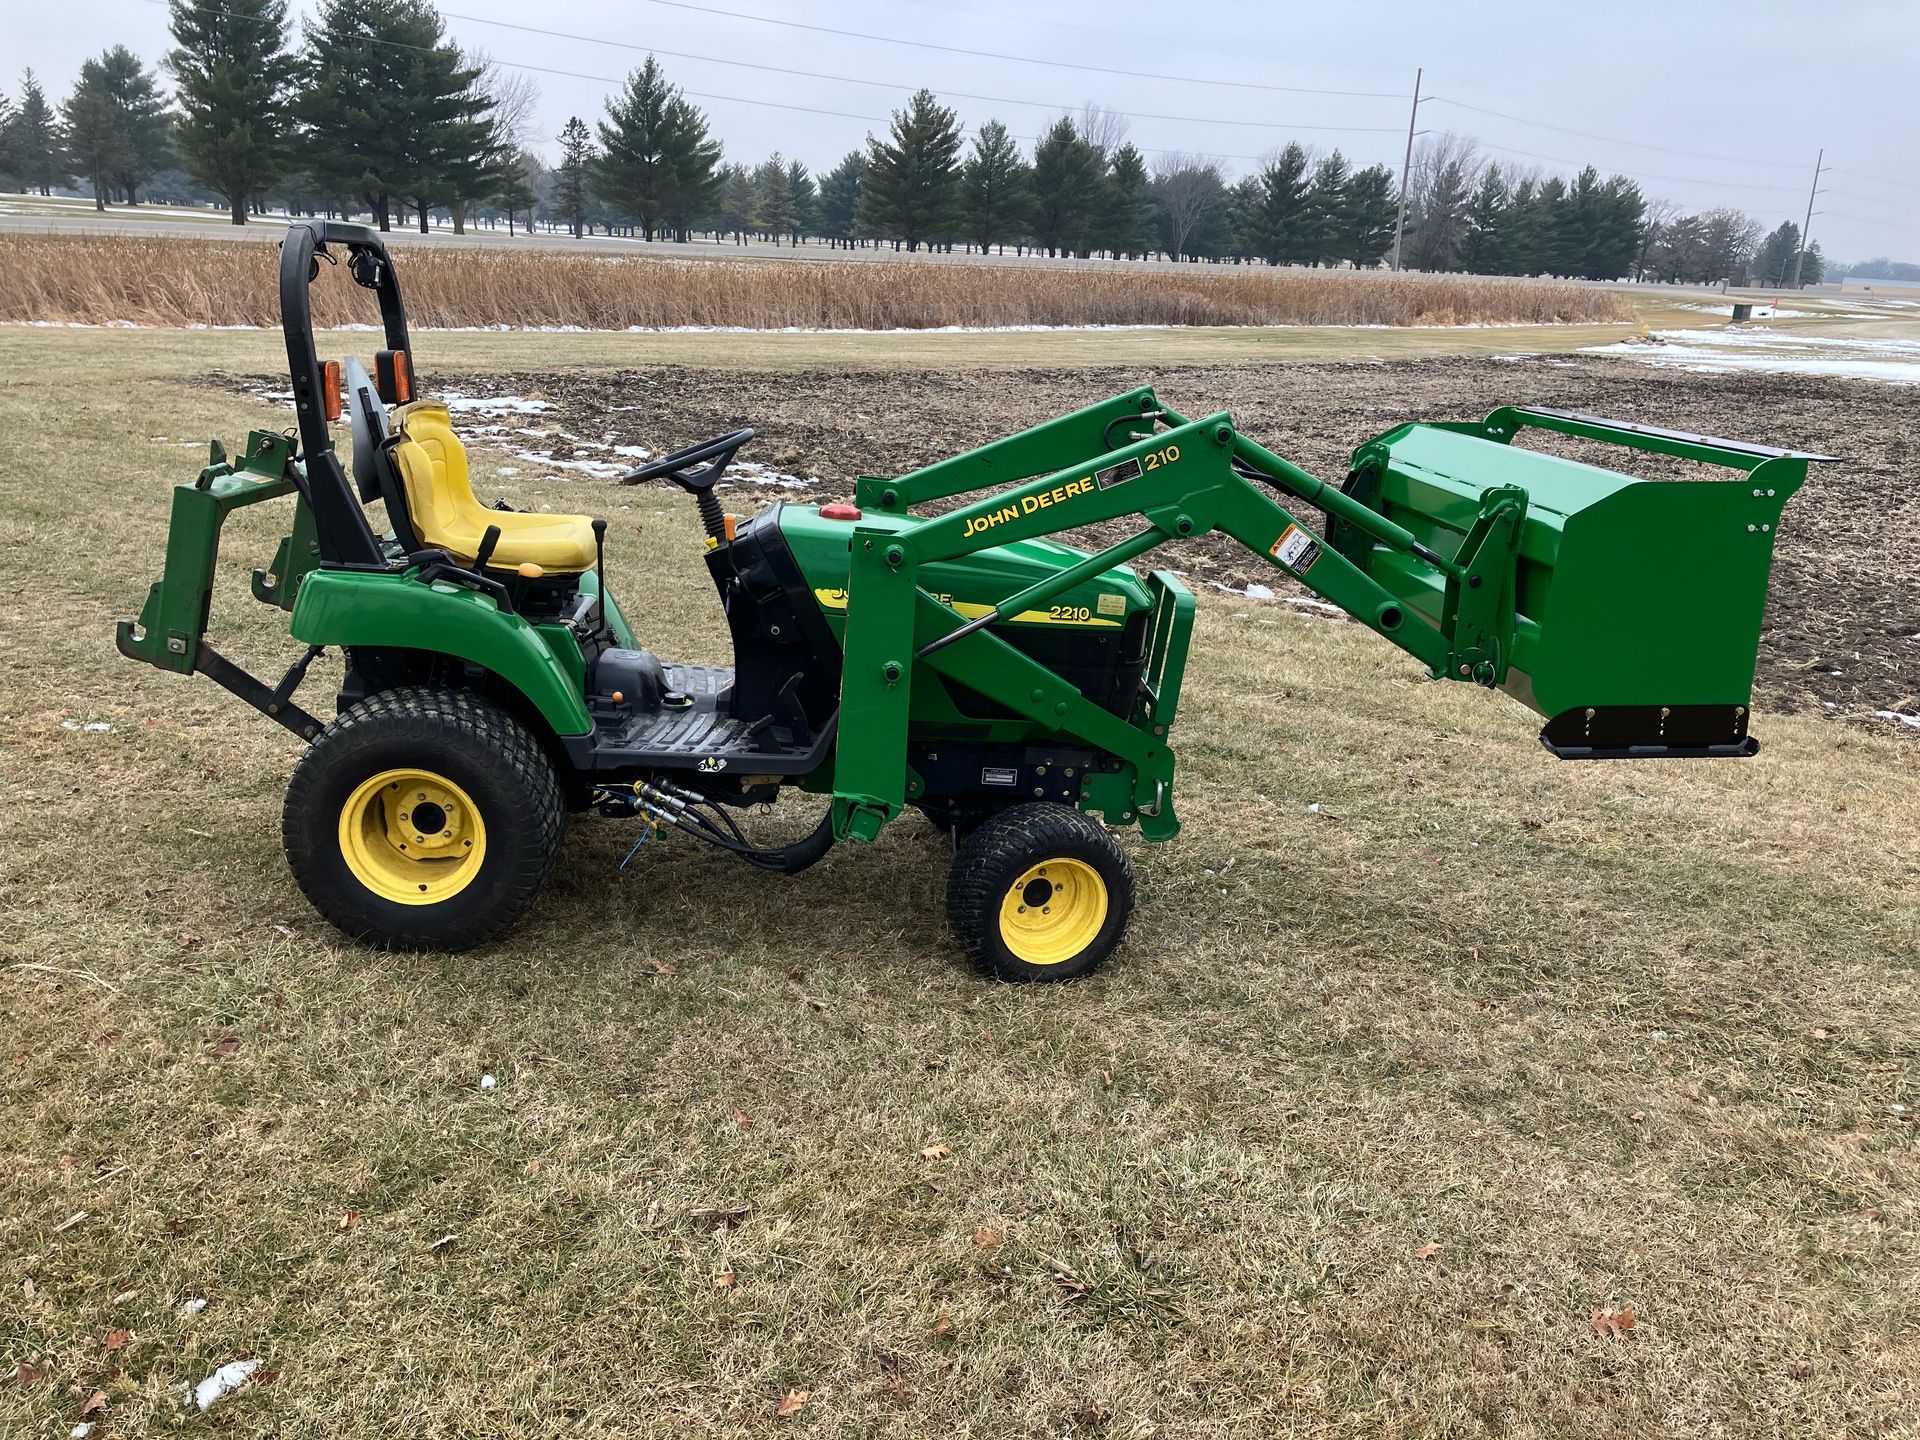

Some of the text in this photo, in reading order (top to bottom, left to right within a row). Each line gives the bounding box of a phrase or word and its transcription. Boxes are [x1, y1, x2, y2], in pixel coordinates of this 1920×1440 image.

[963, 504, 1020, 538] JOHN
[1020, 476, 1095, 515] DEERE
[1144, 445, 1181, 471] 210
[1049, 605, 1091, 621] 2210
